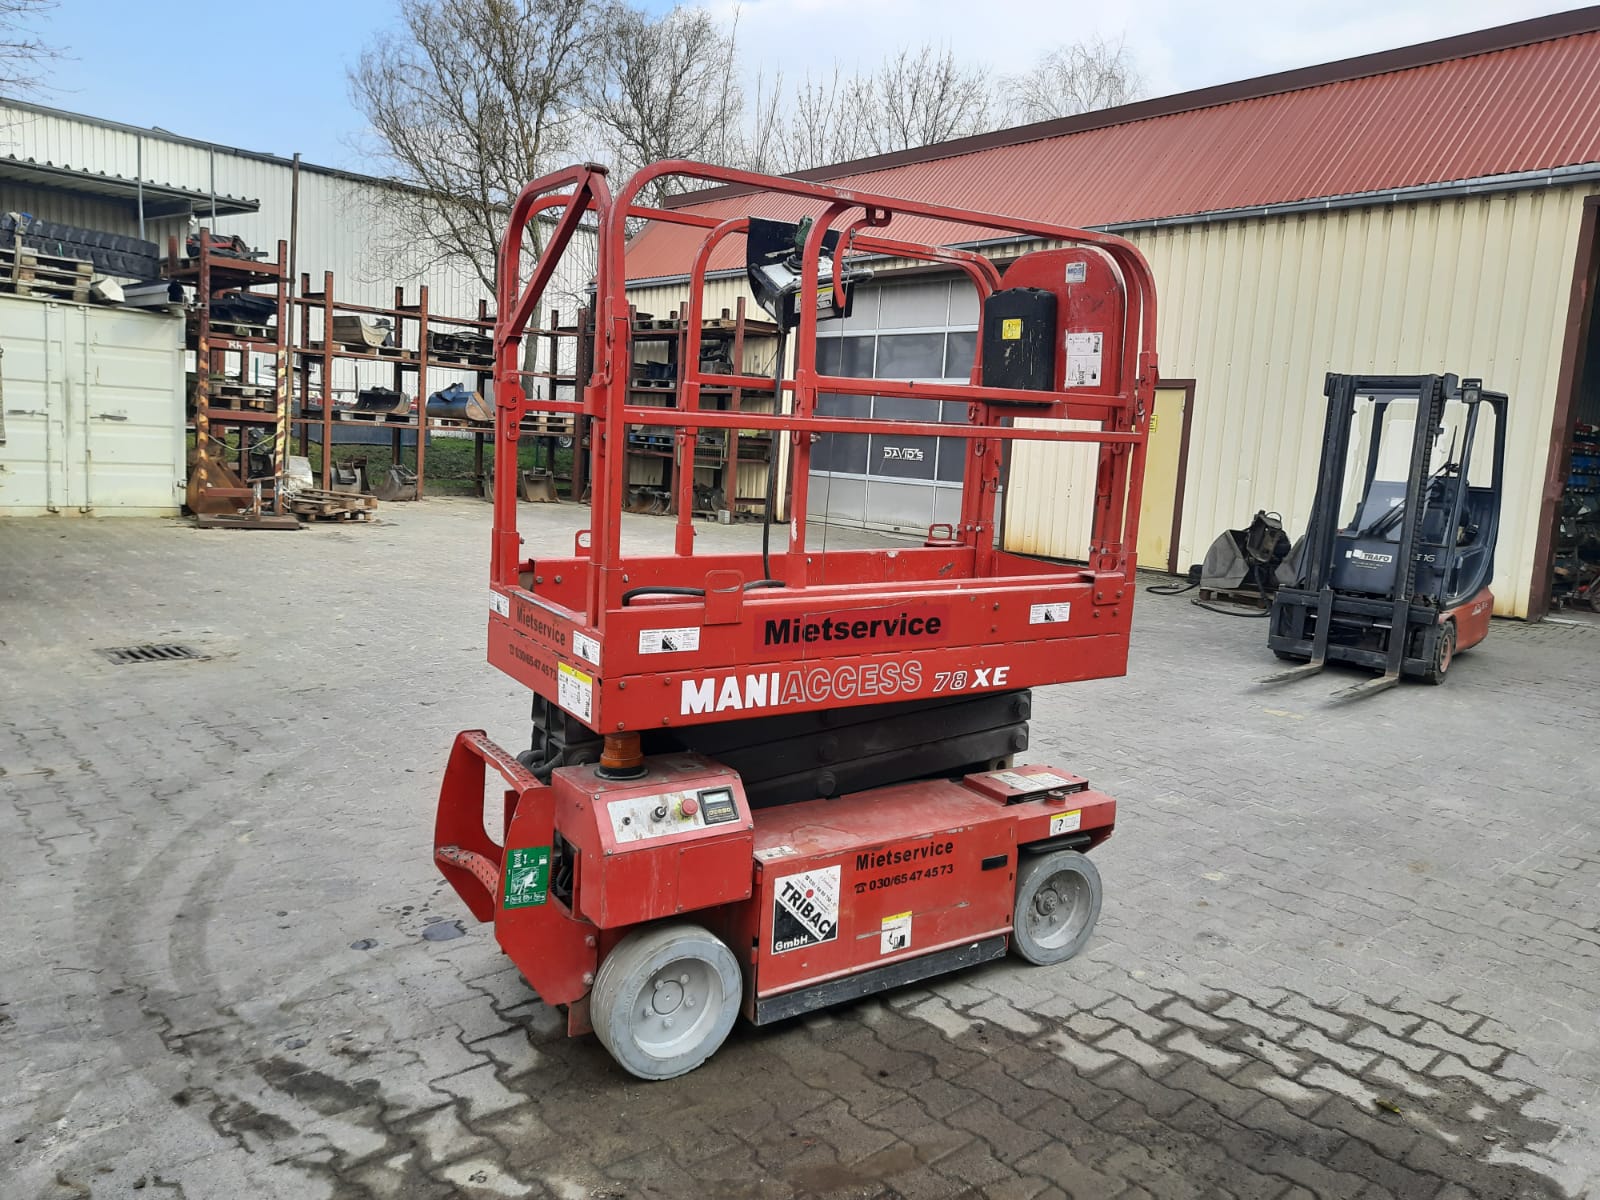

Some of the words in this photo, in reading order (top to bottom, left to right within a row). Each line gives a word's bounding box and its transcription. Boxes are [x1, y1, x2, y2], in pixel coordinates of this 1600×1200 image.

[1363, 552, 1391, 562] TRAFO
[516, 606, 566, 646] Mietservice
[764, 612, 942, 646] Mietservice
[932, 670, 968, 693] 78
[970, 665, 1011, 689] XE
[855, 841, 954, 871] Mietservice
[781, 881, 831, 935] TRIBAC
[775, 934, 808, 951] GmbH
